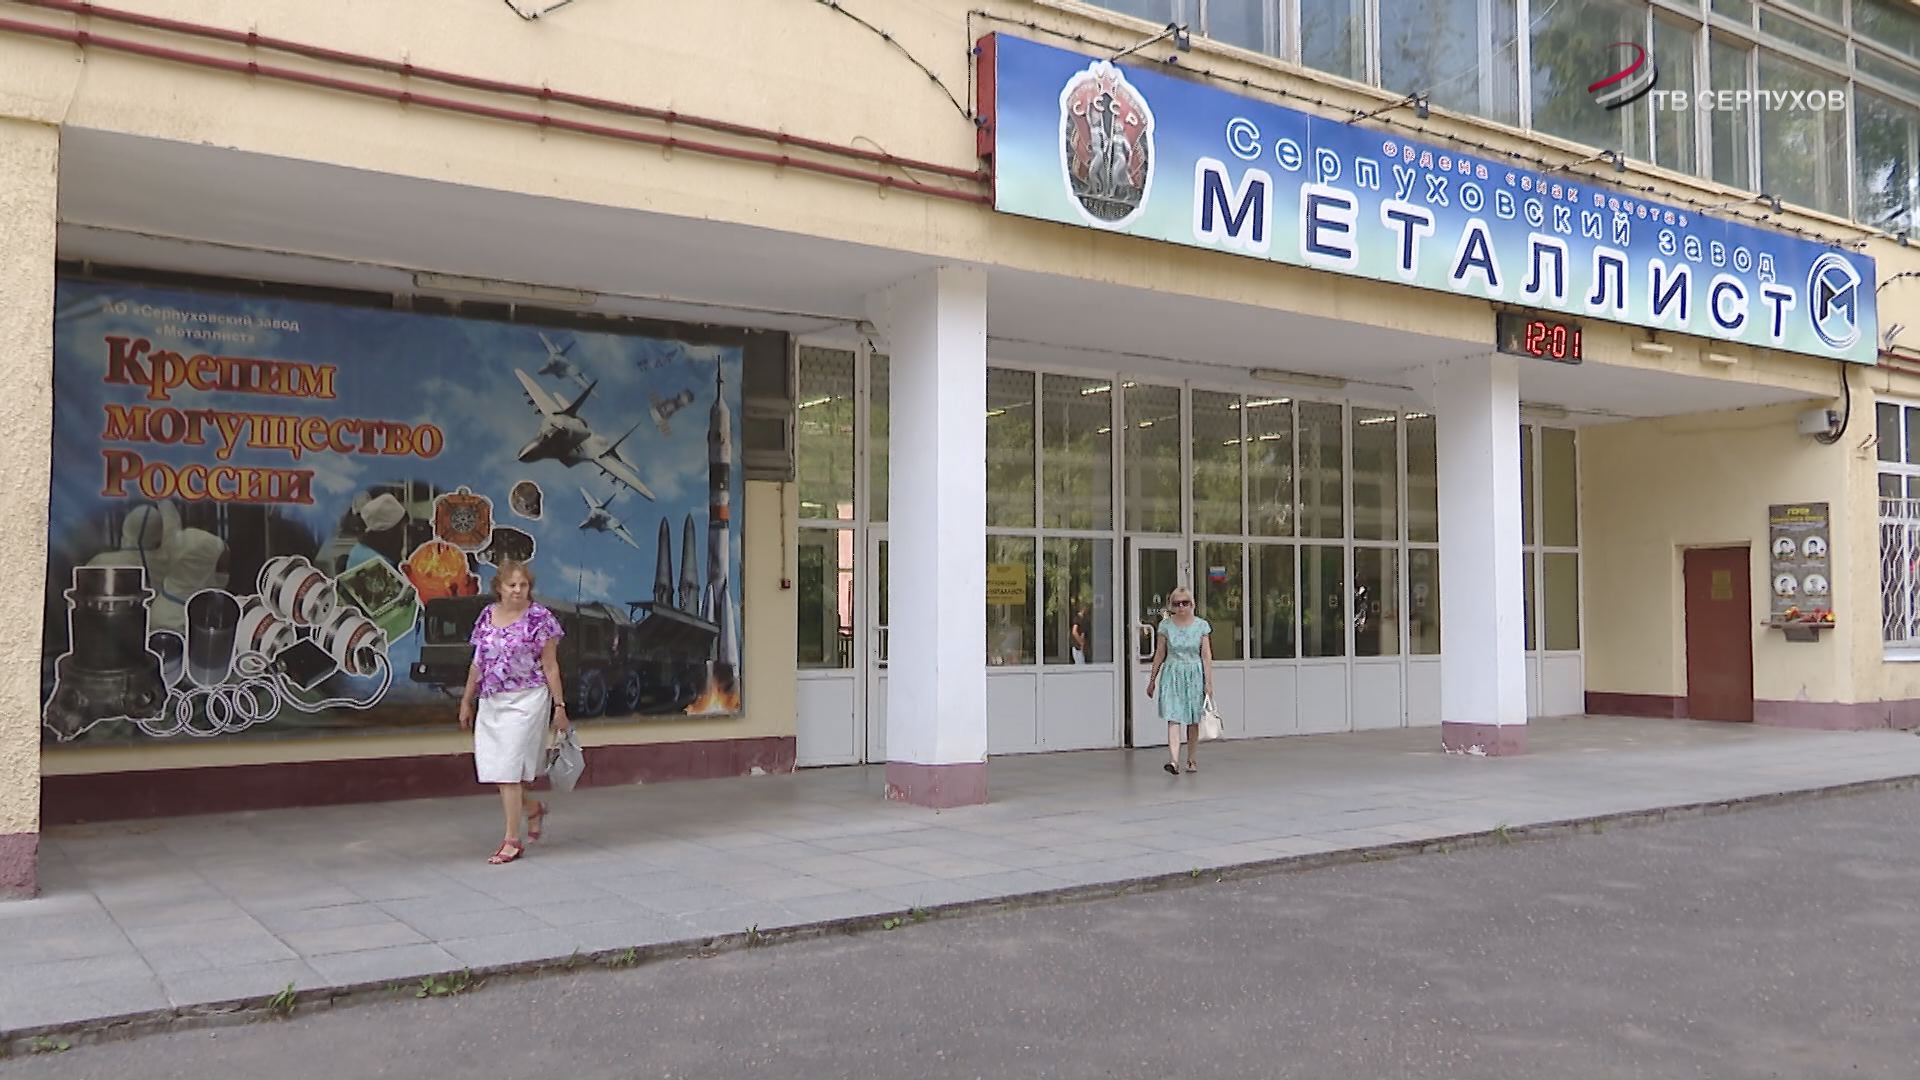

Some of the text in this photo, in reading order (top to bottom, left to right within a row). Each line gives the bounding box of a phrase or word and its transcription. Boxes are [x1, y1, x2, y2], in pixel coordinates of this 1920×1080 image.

[1226, 117, 1776, 283] Серпуховский завод
[1197, 163, 1795, 341] МЕТАЛЛИСТ
[103, 302, 127, 315] АО
[103, 335, 336, 401] Крепим
[1526, 321, 1582, 359] 12:01
[101, 403, 444, 460] могущество
[102, 448, 315, 505] России
